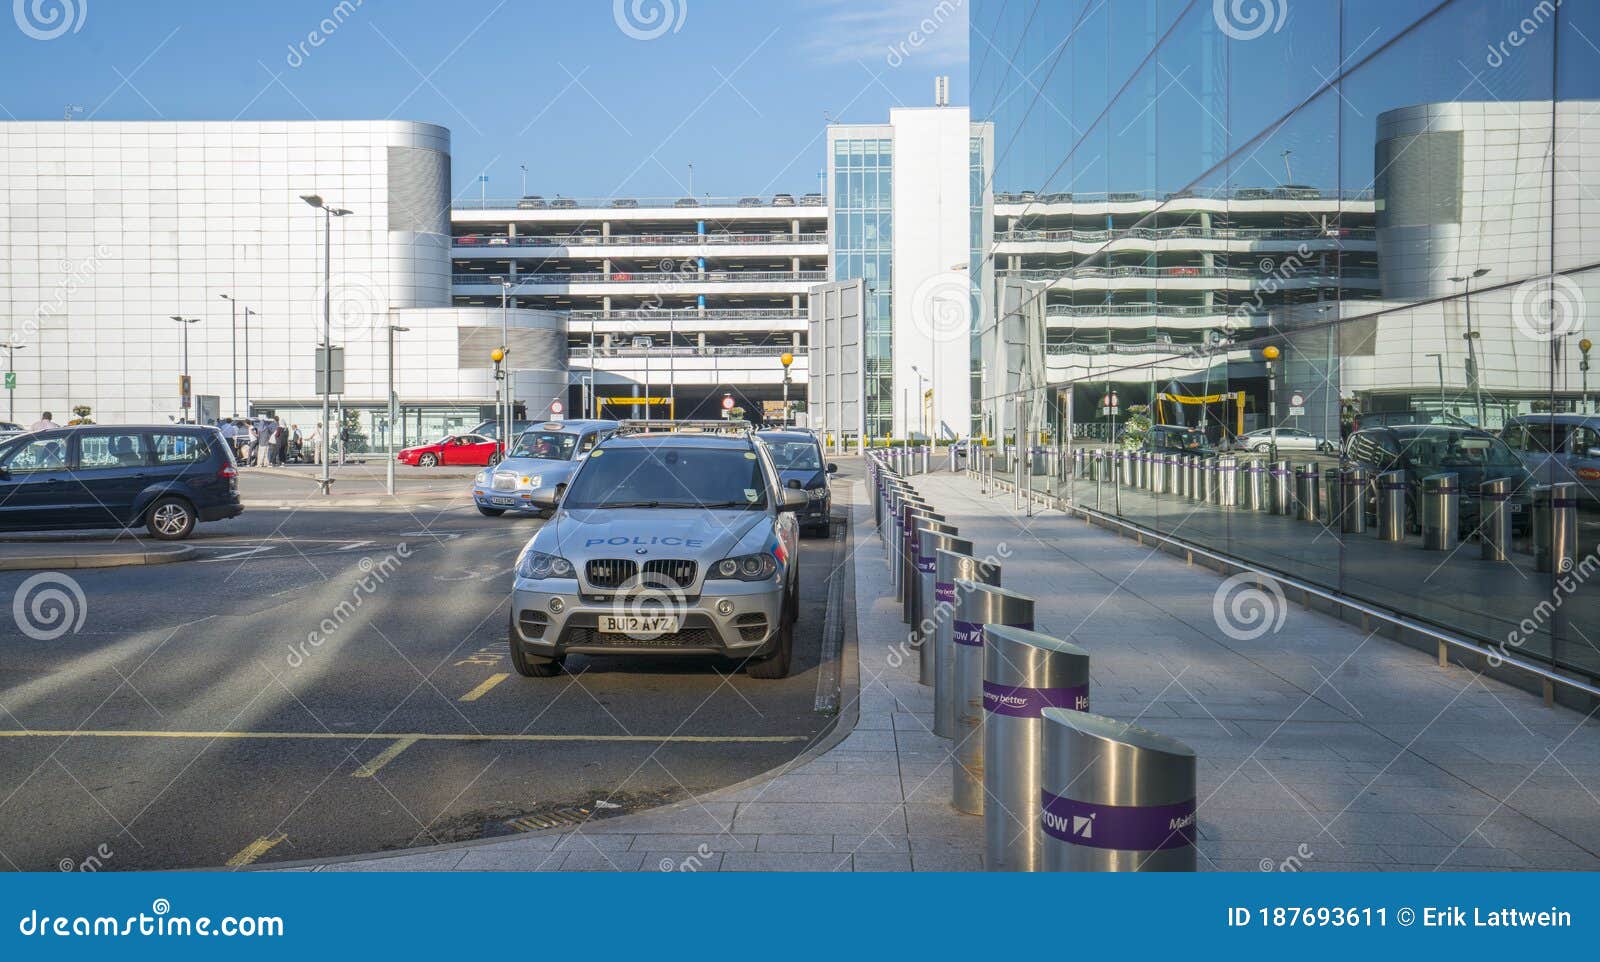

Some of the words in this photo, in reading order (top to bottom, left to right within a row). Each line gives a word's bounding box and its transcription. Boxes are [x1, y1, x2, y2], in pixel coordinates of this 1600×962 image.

[585, 536, 704, 548] POLICE
[642, 617, 670, 631] AYZ
[1000, 694, 1028, 706] better
